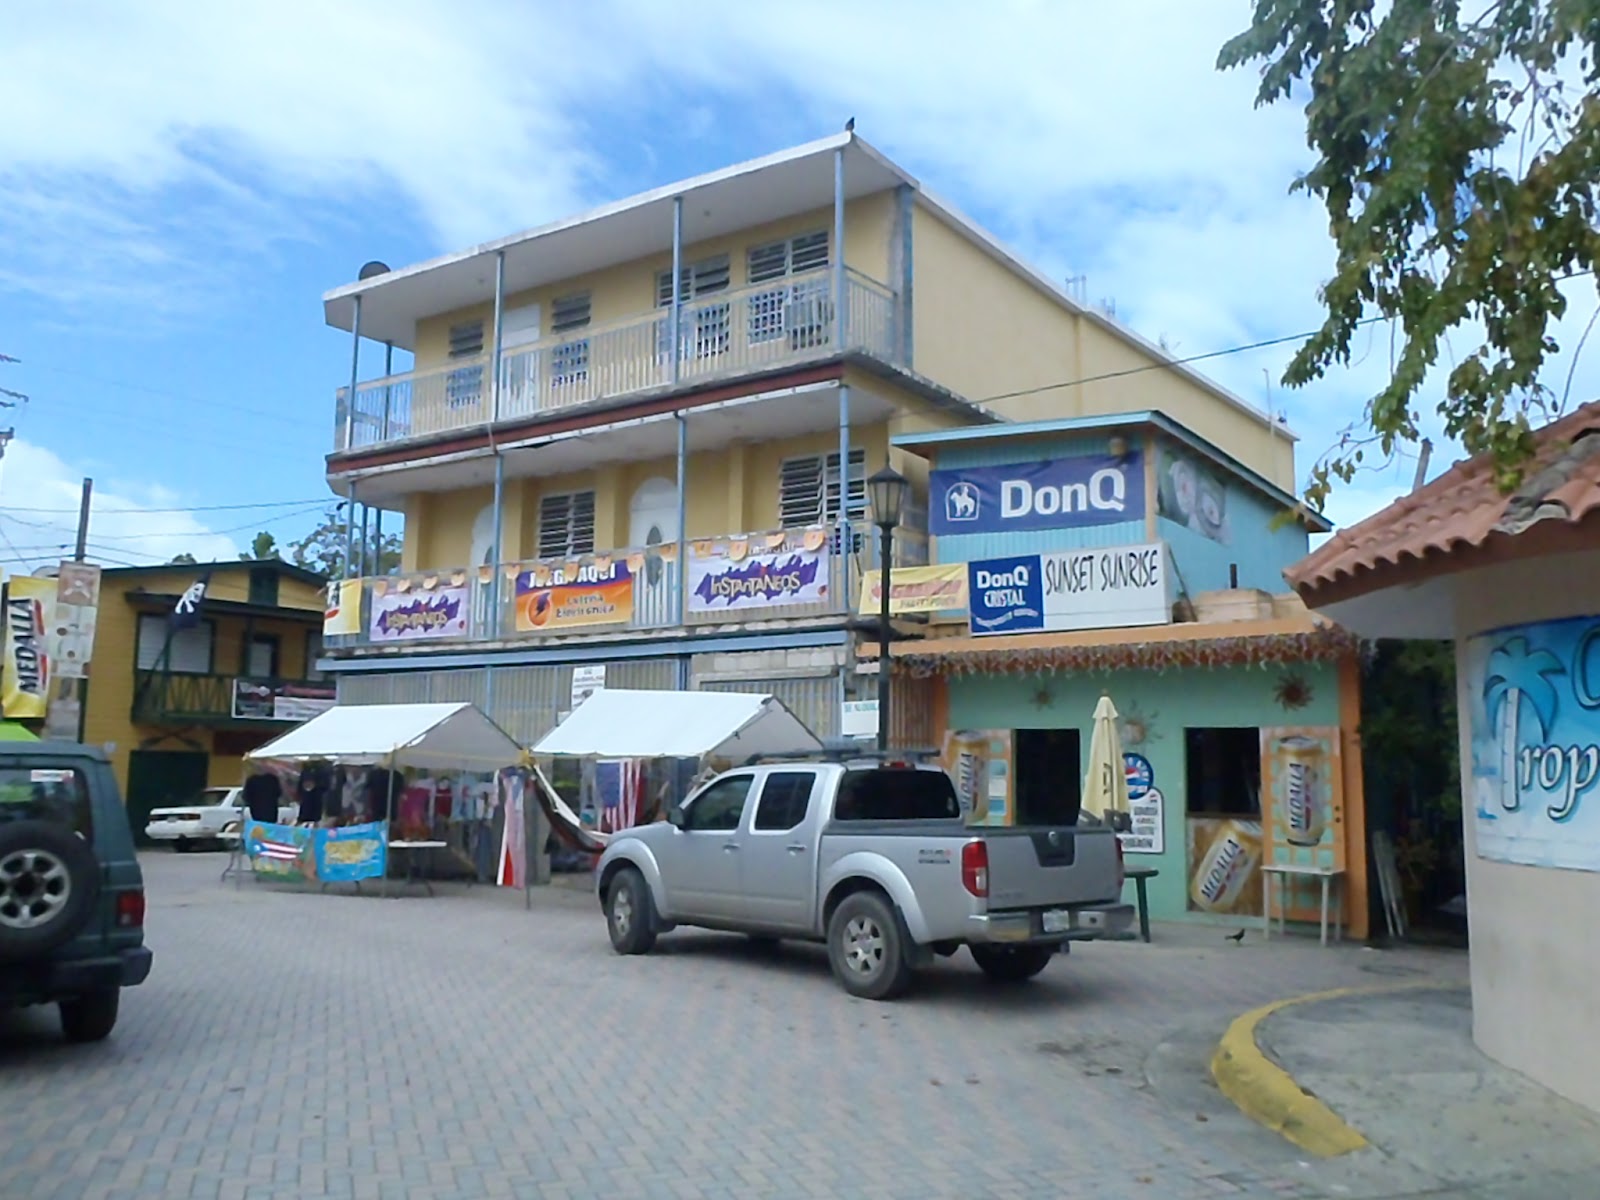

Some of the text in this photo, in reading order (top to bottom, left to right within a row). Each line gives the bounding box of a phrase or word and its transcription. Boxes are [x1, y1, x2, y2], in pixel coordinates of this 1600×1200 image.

[1001, 468, 1125, 518] DonQ
[528, 568, 572, 588] JEG
[977, 566, 1029, 589] DonQ
[1046, 550, 1157, 595] SUNSET SUNRISE
[984, 590, 1026, 608] CRISTAL
[9, 597, 40, 696] MEDALLA
[1288, 762, 1303, 830] MEDALLA
[1200, 839, 1240, 899] MEDALLA
